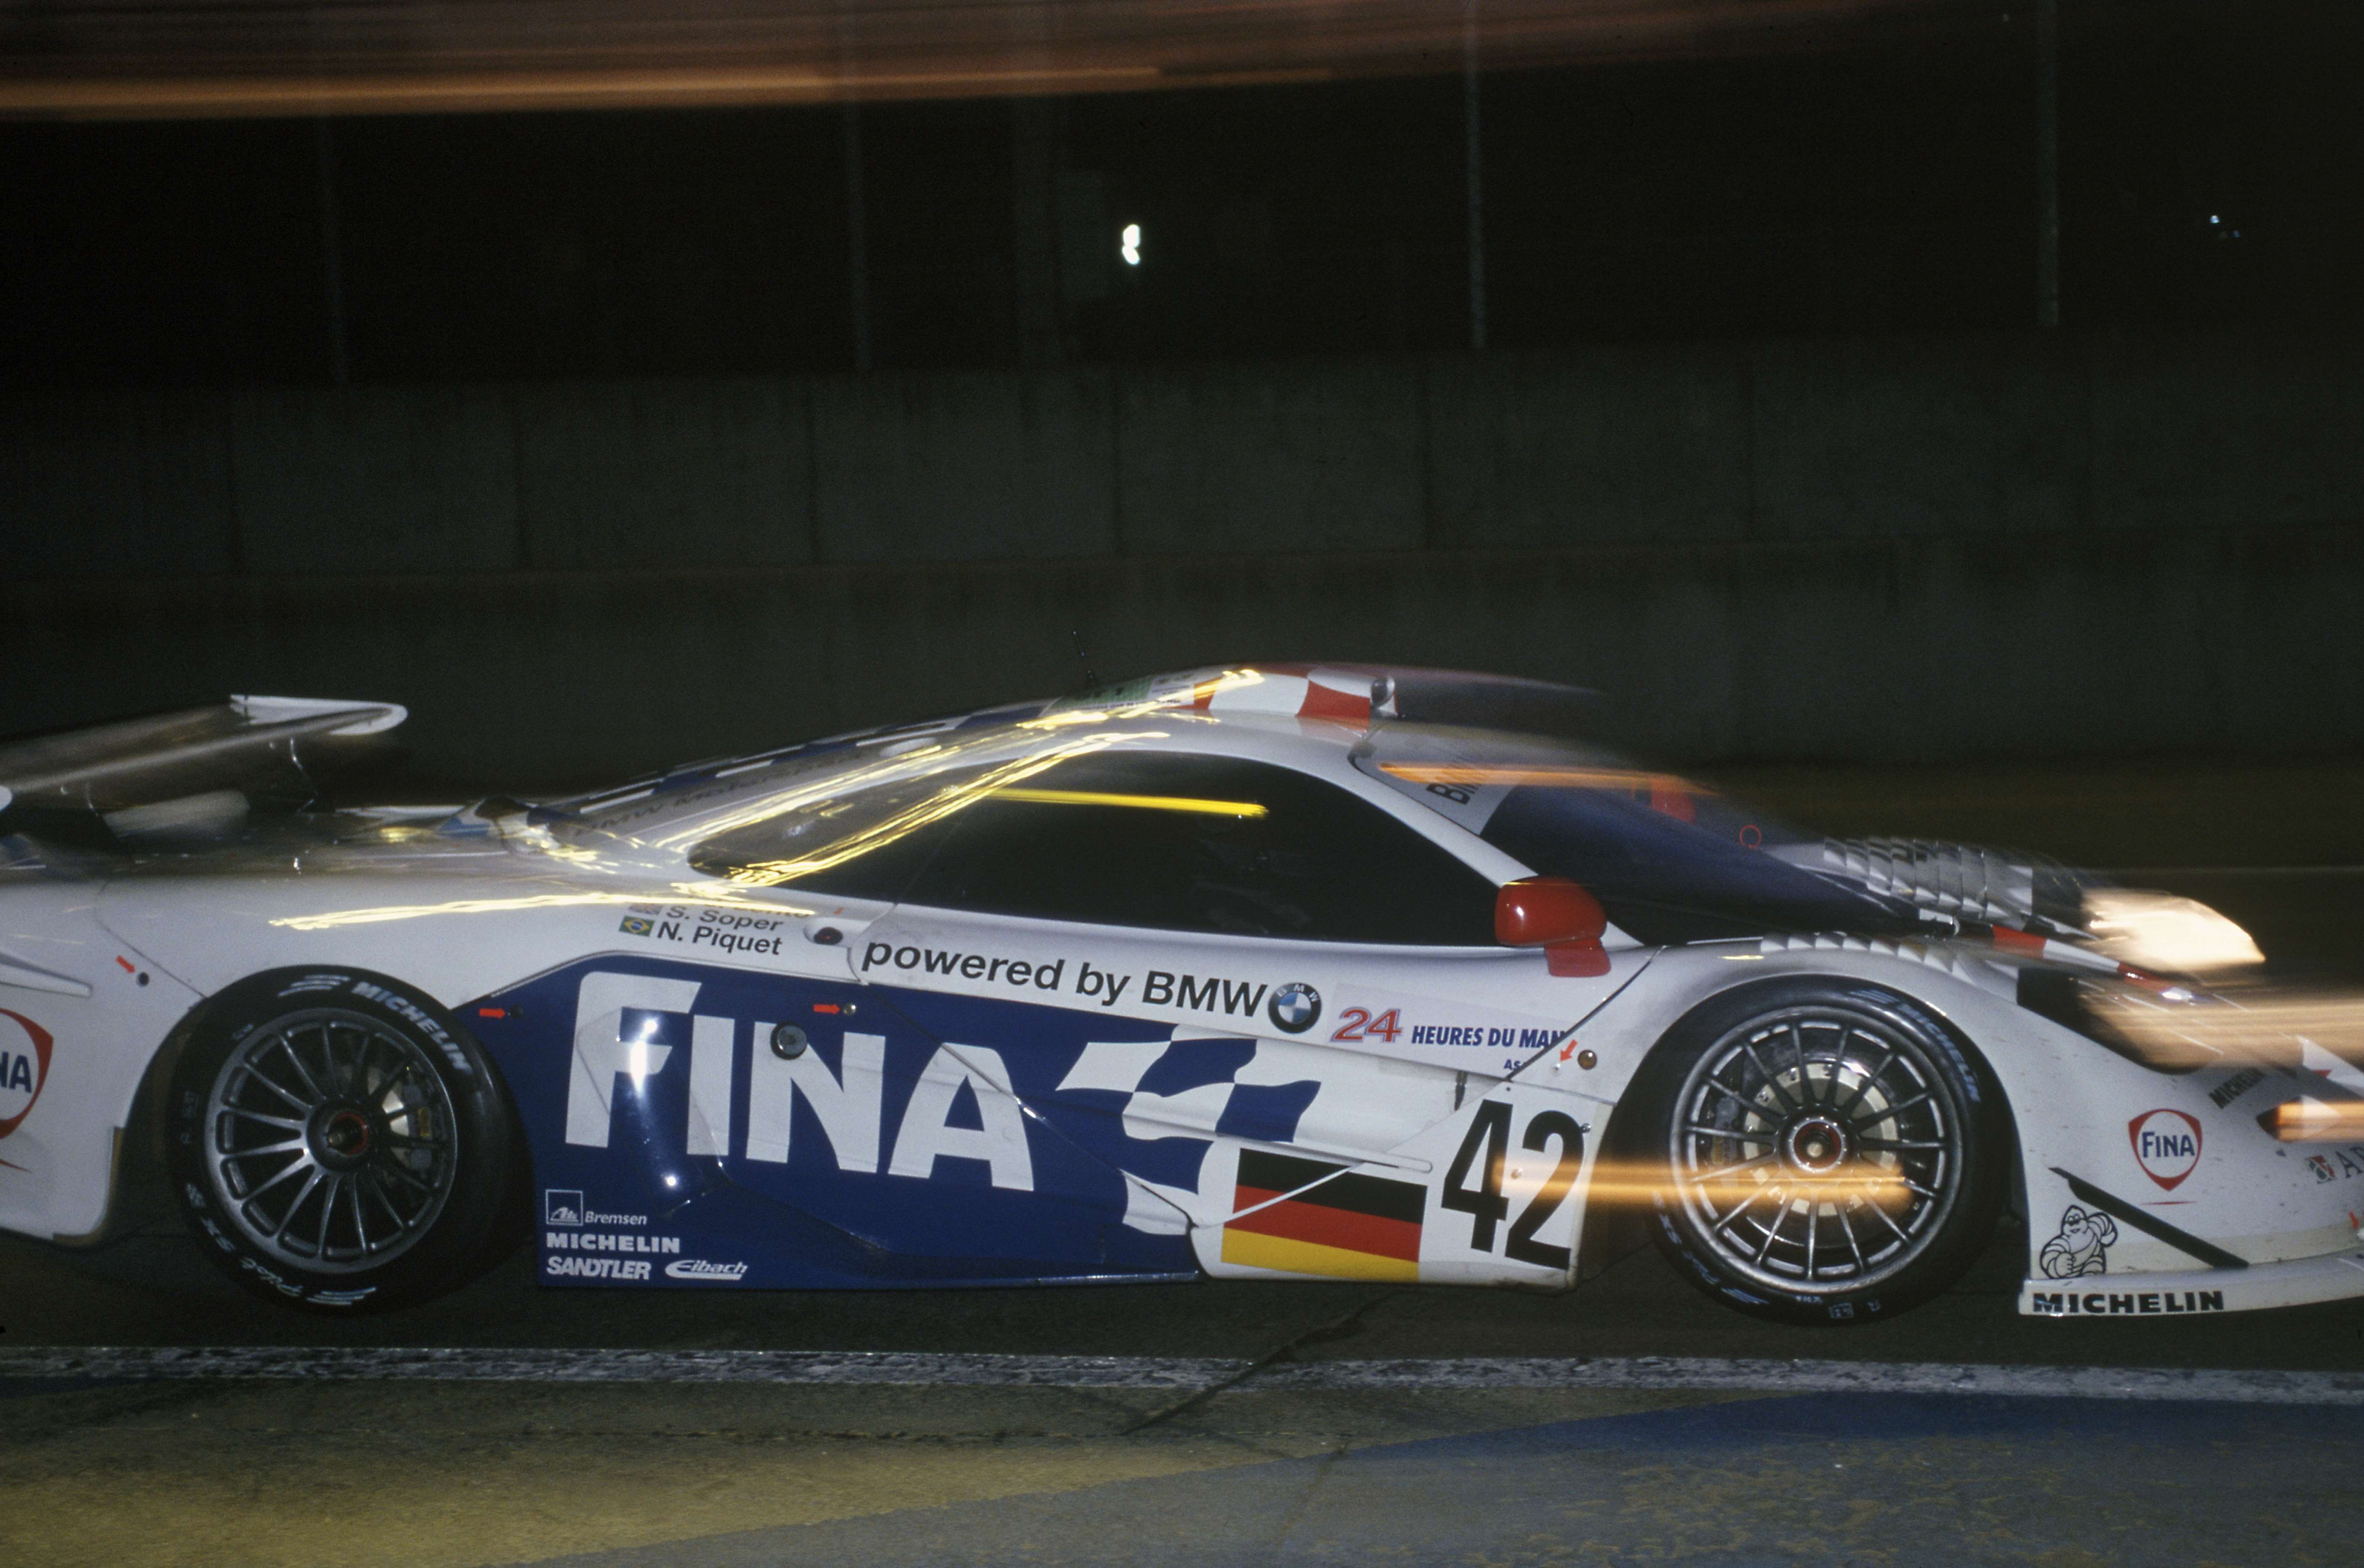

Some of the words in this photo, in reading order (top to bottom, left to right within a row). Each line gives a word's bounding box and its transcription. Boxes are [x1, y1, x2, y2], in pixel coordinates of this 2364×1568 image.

[667, 906, 690, 920] S.
[699, 909, 784, 931] Soper
[657, 921, 683, 941] N.
[693, 925, 782, 955] Piquet
[862, 941, 1064, 990] powered
[1076, 962, 1130, 1006] by
[1142, 970, 1267, 1017] BMW
[351, 981, 472, 1074] MICHELIN
[1330, 1007, 1403, 1043] 24
[1411, 1025, 1482, 1046] HEURES
[1488, 1028, 1518, 1048] DU
[565, 971, 1034, 1192] FINA
[2141, 1131, 2195, 1159] FINA
[1441, 1099, 1585, 1271] 42
[585, 1211, 647, 1225] Bremsen
[547, 1232, 680, 1253] MICHELIN
[547, 1256, 651, 1280] SANDTLER
[665, 1259, 748, 1280] Eibach
[2033, 1291, 2225, 1314] MICHELIN
